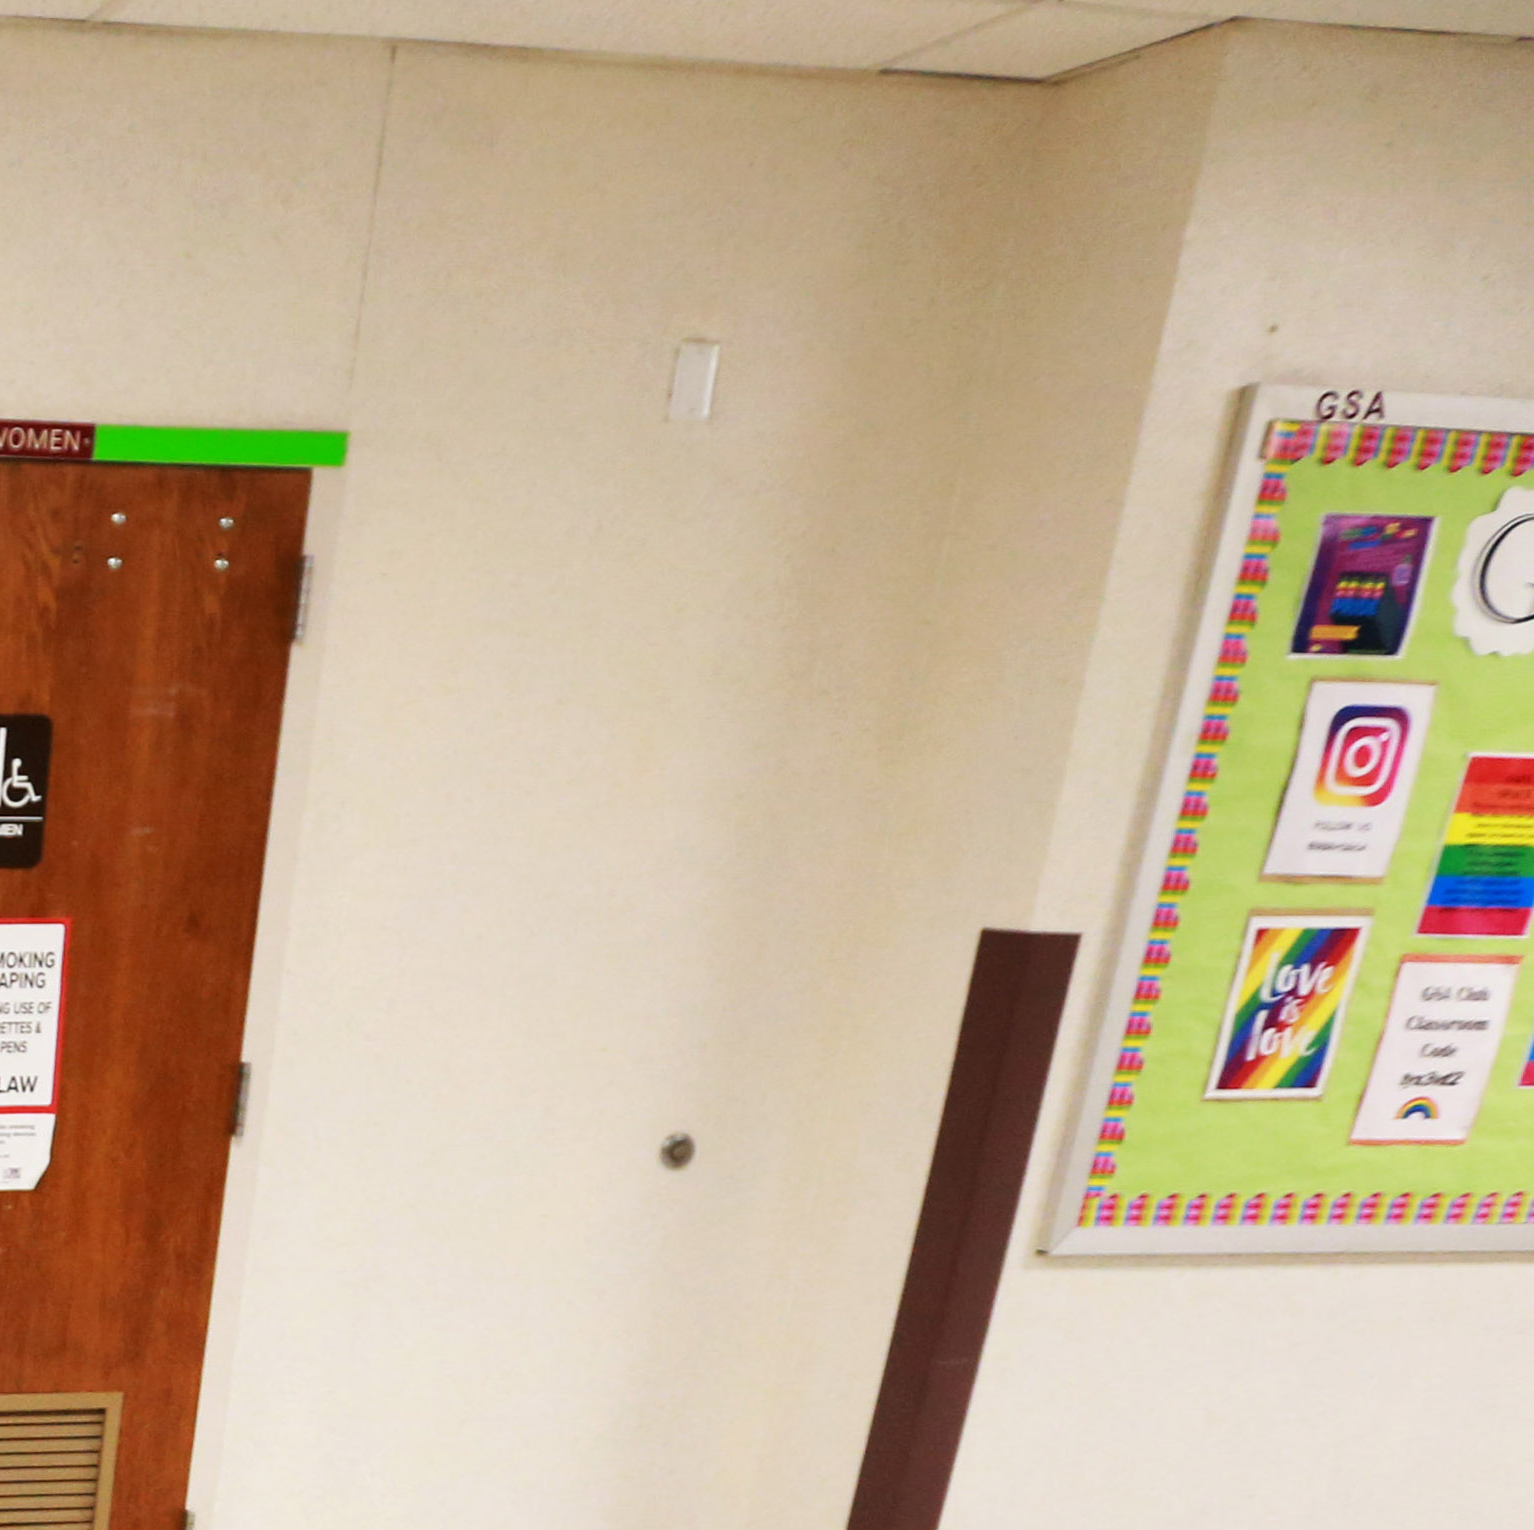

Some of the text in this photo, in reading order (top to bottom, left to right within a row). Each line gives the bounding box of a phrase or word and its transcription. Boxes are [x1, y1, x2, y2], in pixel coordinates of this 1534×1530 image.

[1316, 390, 1385, 420] GSA
[13, 1001, 34, 1014] USE
[37, 1001, 52, 1014] OF
[0, 1040, 28, 1053] PENS
